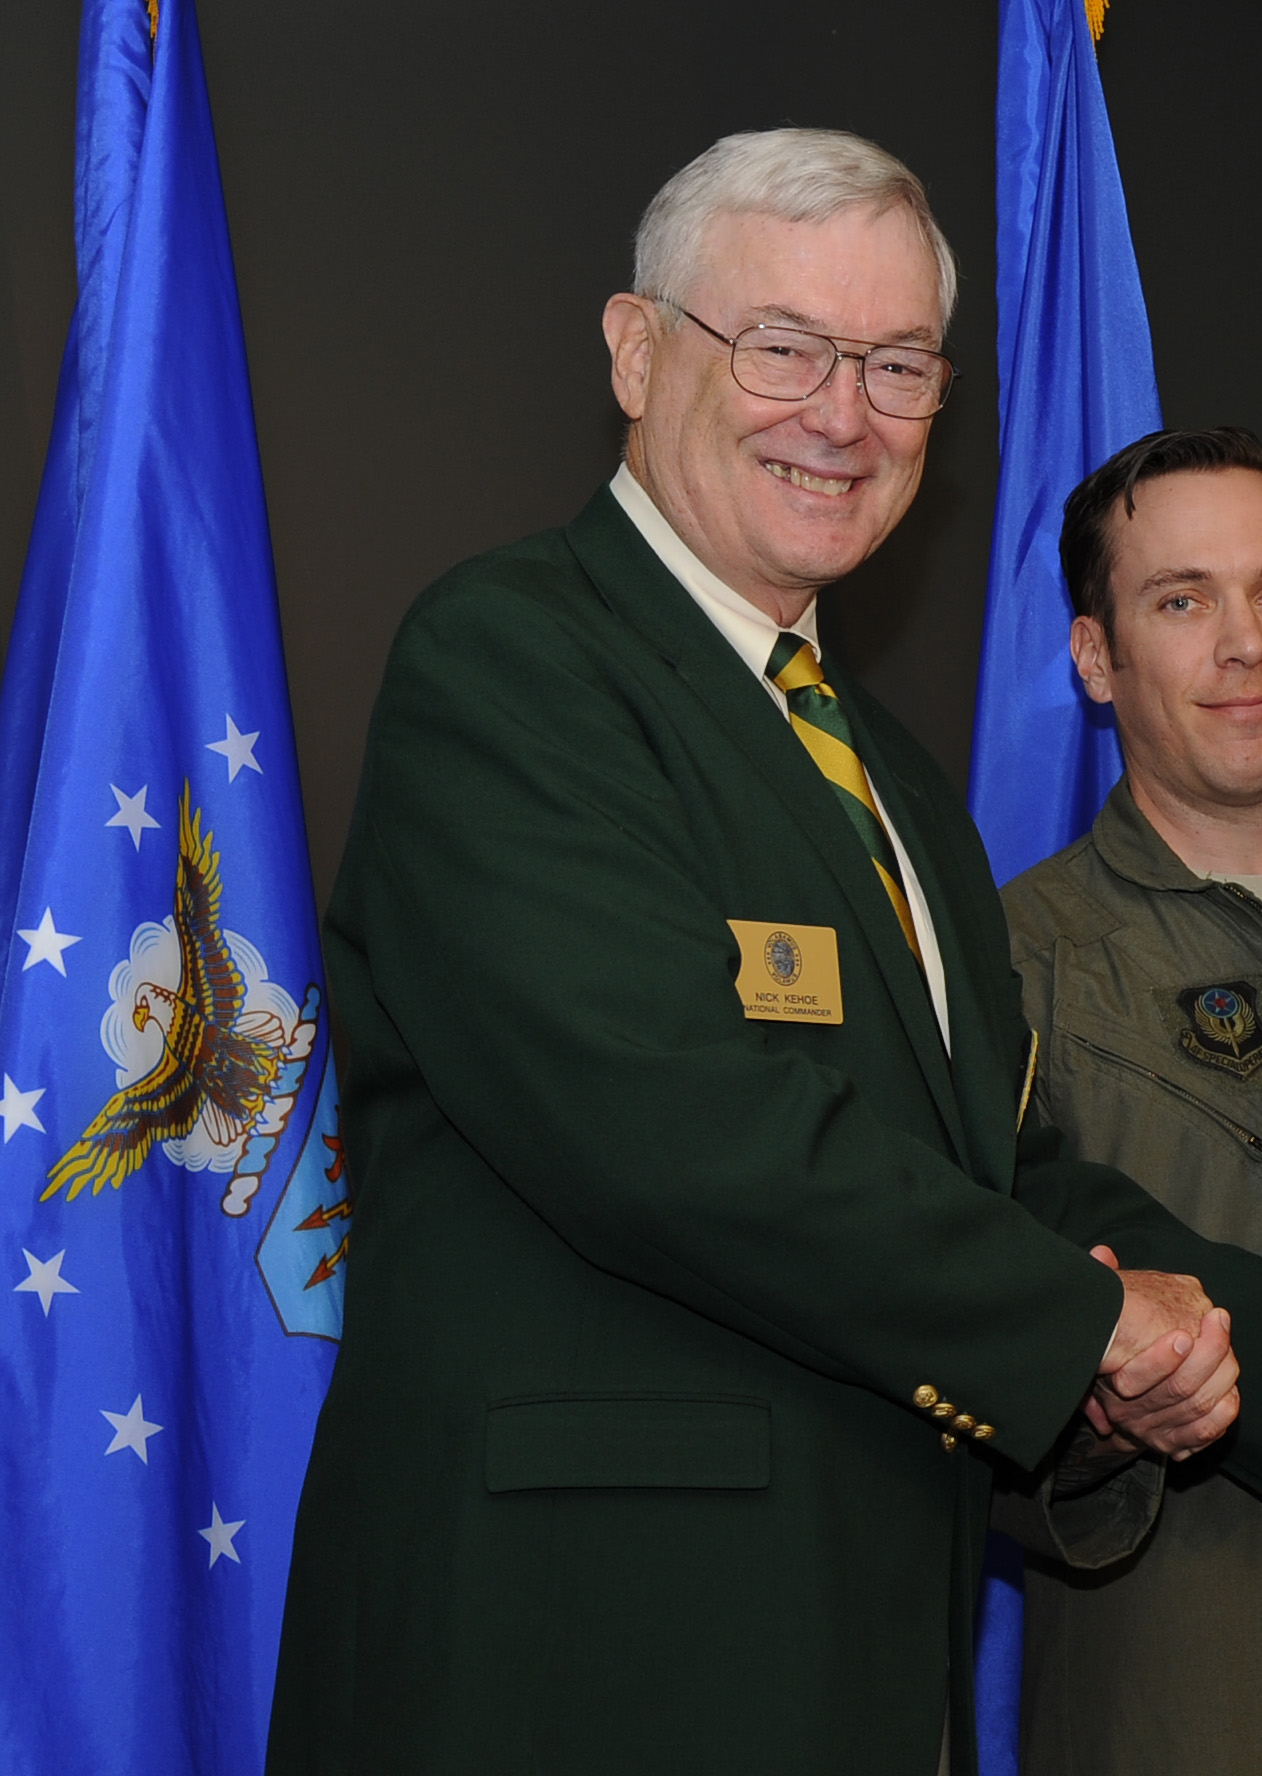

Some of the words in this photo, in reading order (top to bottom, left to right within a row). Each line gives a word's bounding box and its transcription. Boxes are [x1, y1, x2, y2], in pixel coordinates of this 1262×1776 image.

[756, 993, 779, 1002] NICK
[785, 995, 818, 1005] KEHOE
[744, 1005, 780, 1013] NATIONAL
[783, 1007, 831, 1016] COMMANDER
